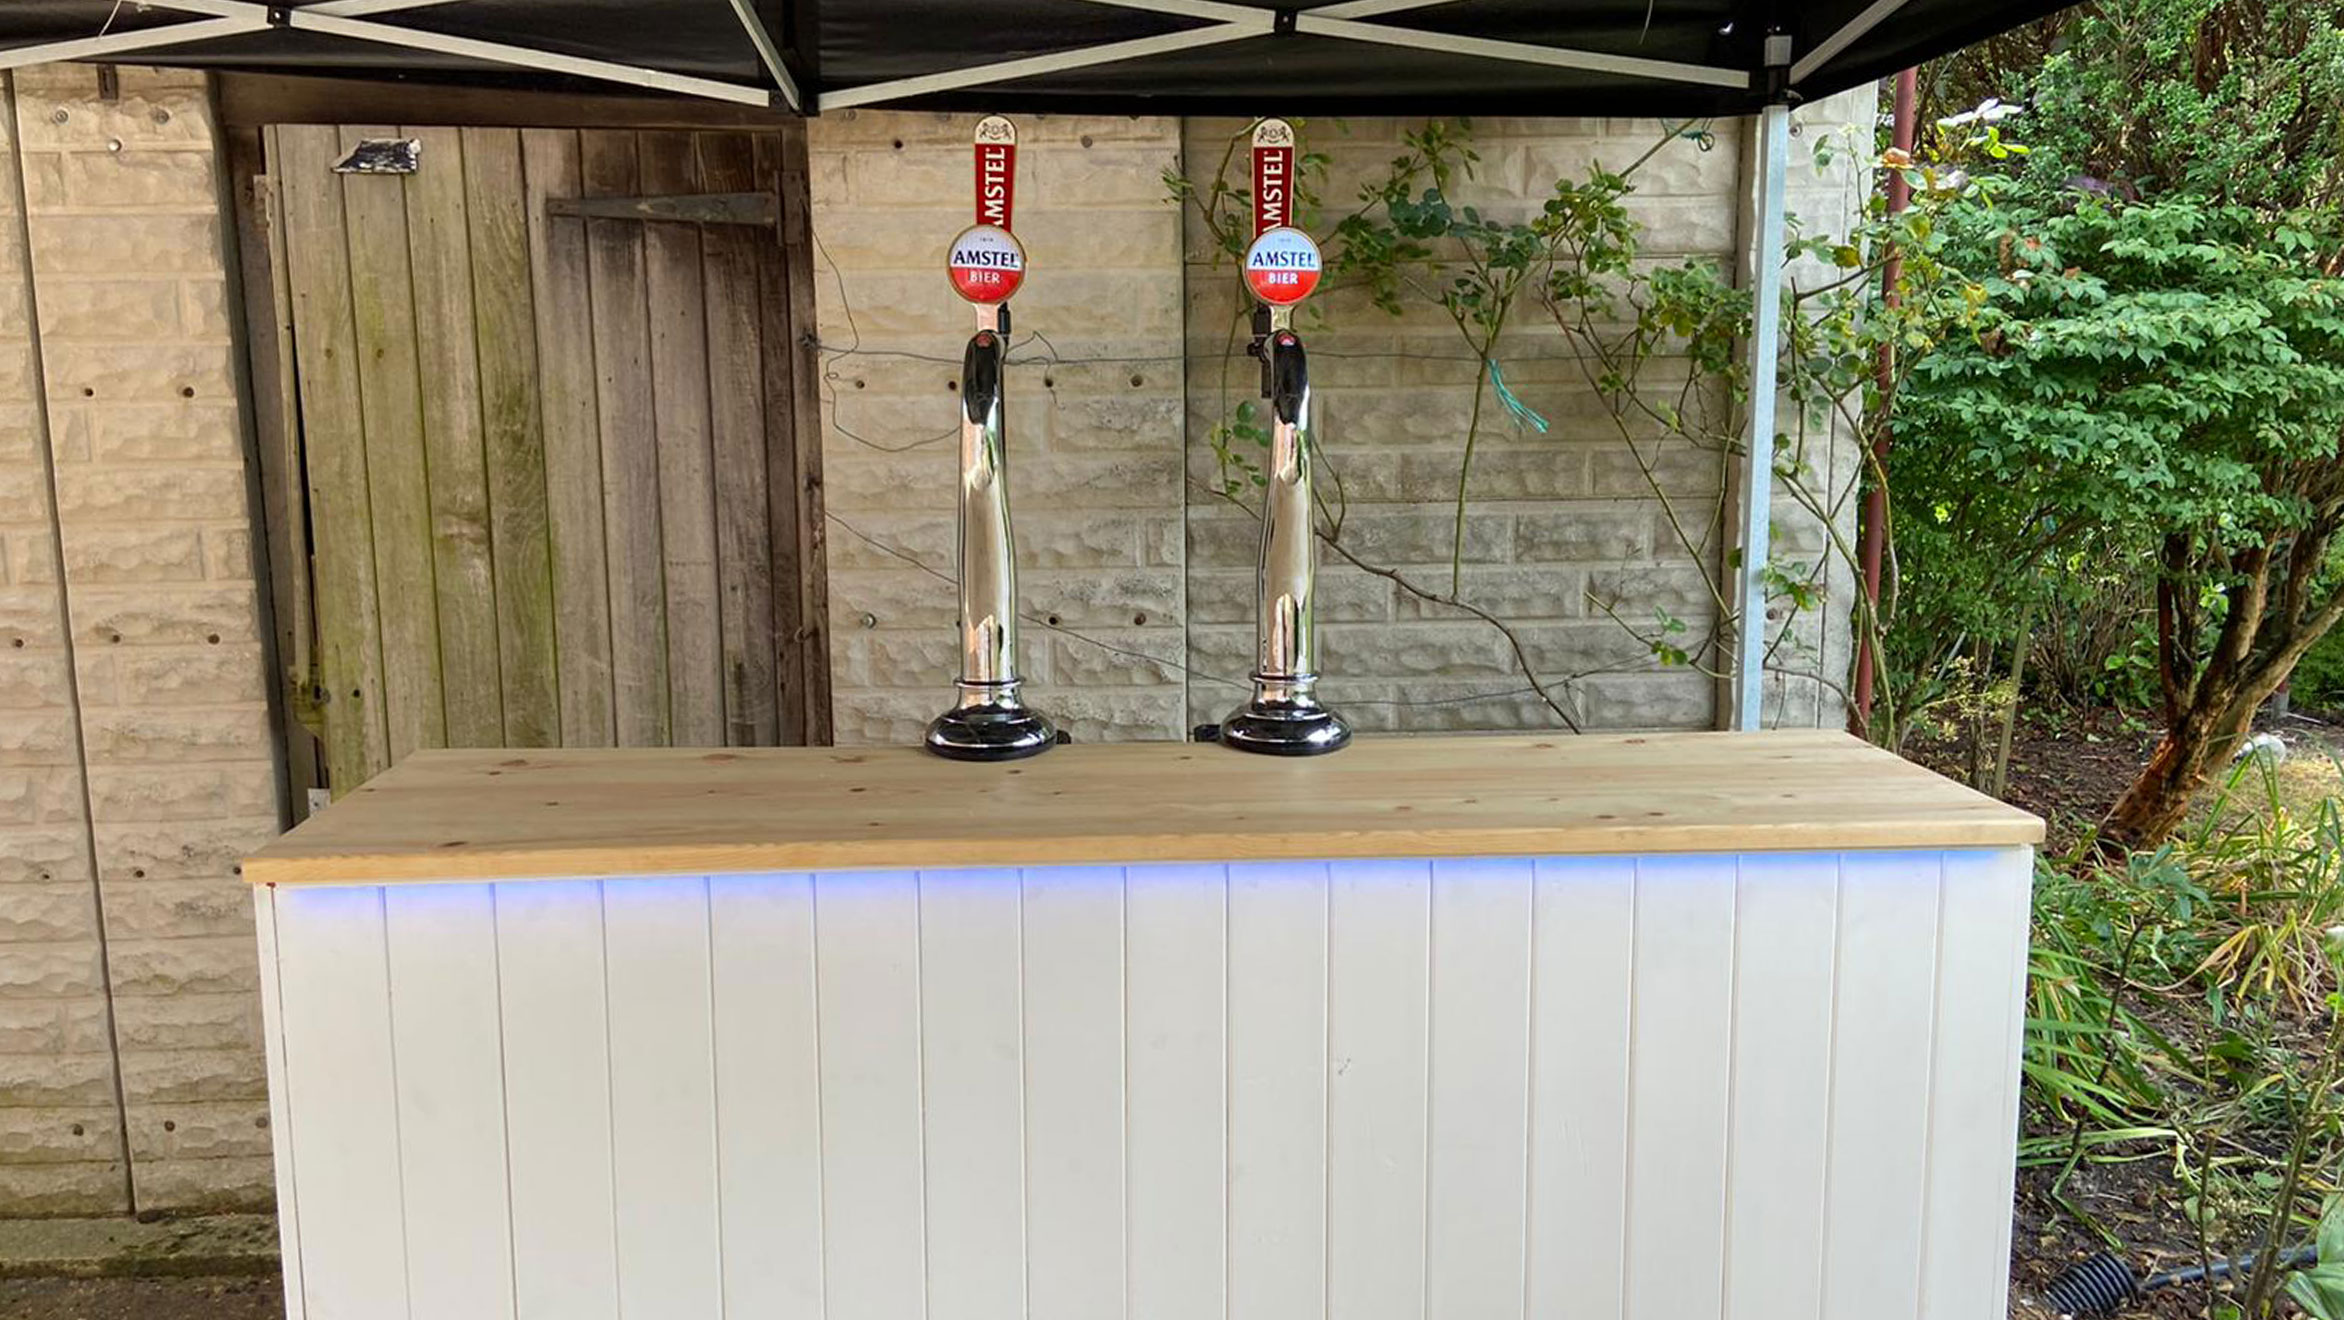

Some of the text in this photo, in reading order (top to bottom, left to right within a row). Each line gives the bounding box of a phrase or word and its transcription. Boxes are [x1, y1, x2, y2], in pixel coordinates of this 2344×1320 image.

[953, 251, 1018, 268] AMSTEL
[1253, 251, 1315, 268] AMSTEL
[969, 271, 1000, 284] BIER
[1268, 271, 1299, 284] BIER
